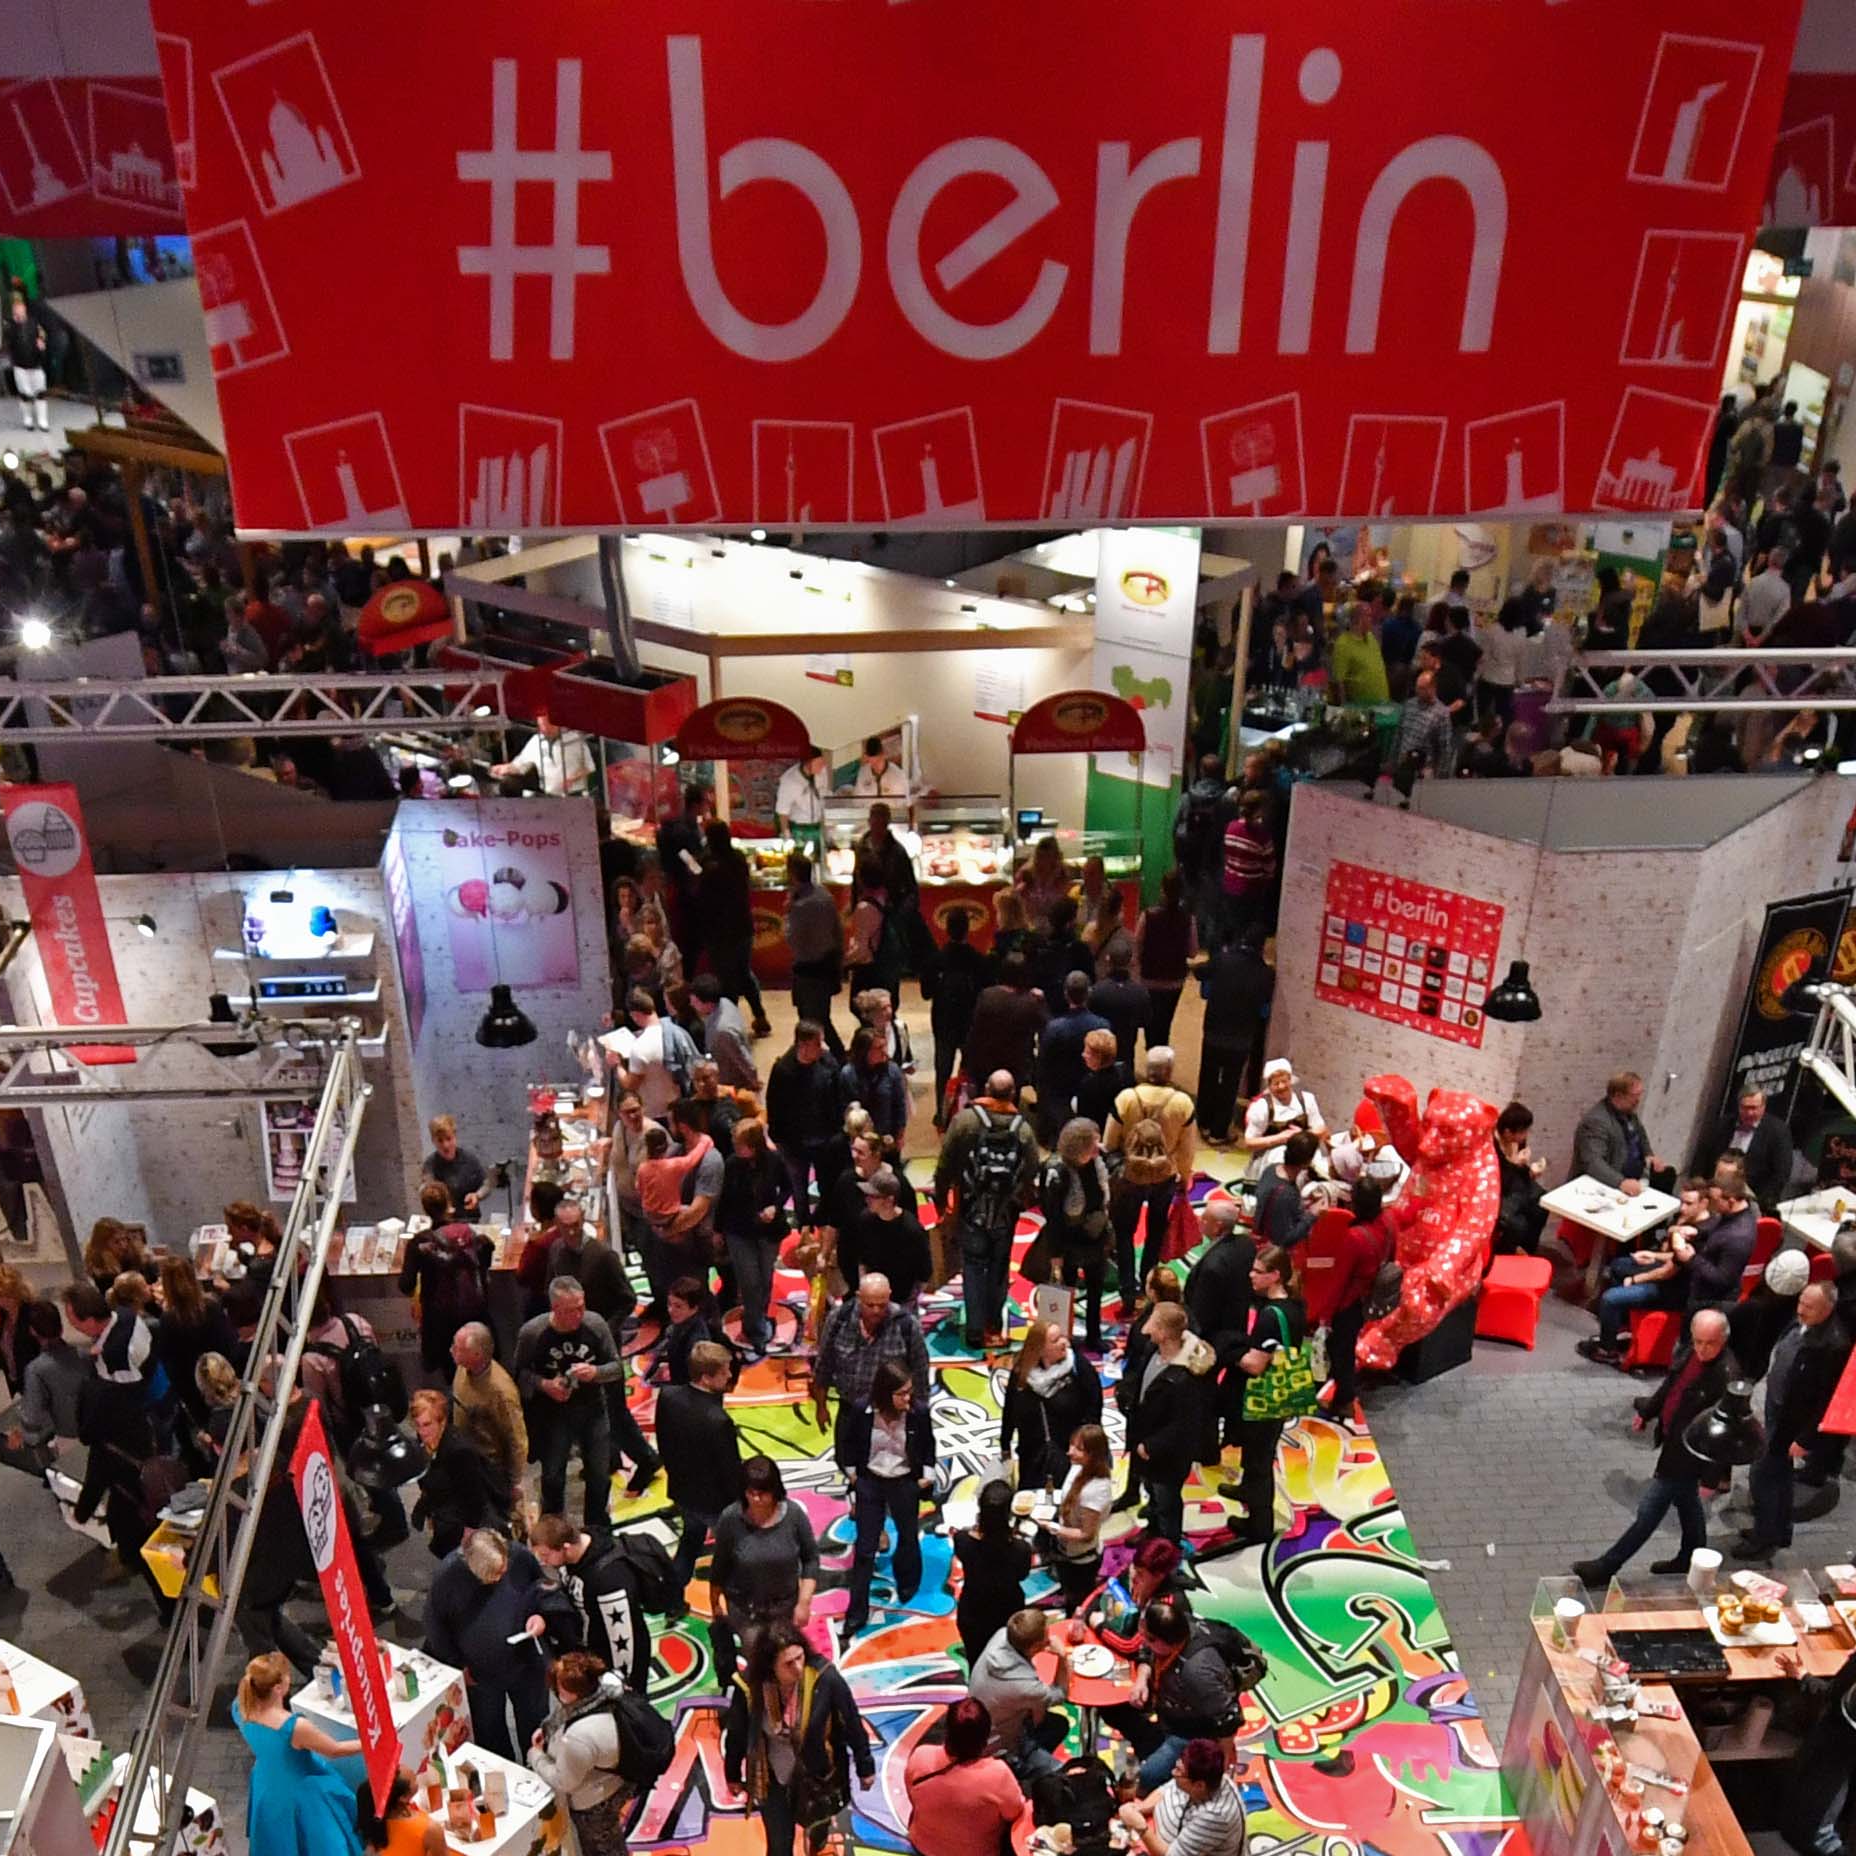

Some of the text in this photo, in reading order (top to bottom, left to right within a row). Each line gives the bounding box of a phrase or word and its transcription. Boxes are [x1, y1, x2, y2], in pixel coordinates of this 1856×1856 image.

[456, 34, 1510, 362] #berlin
[53, 894, 98, 1025] Cupcakes
[1372, 888, 1450, 930] #berlin
